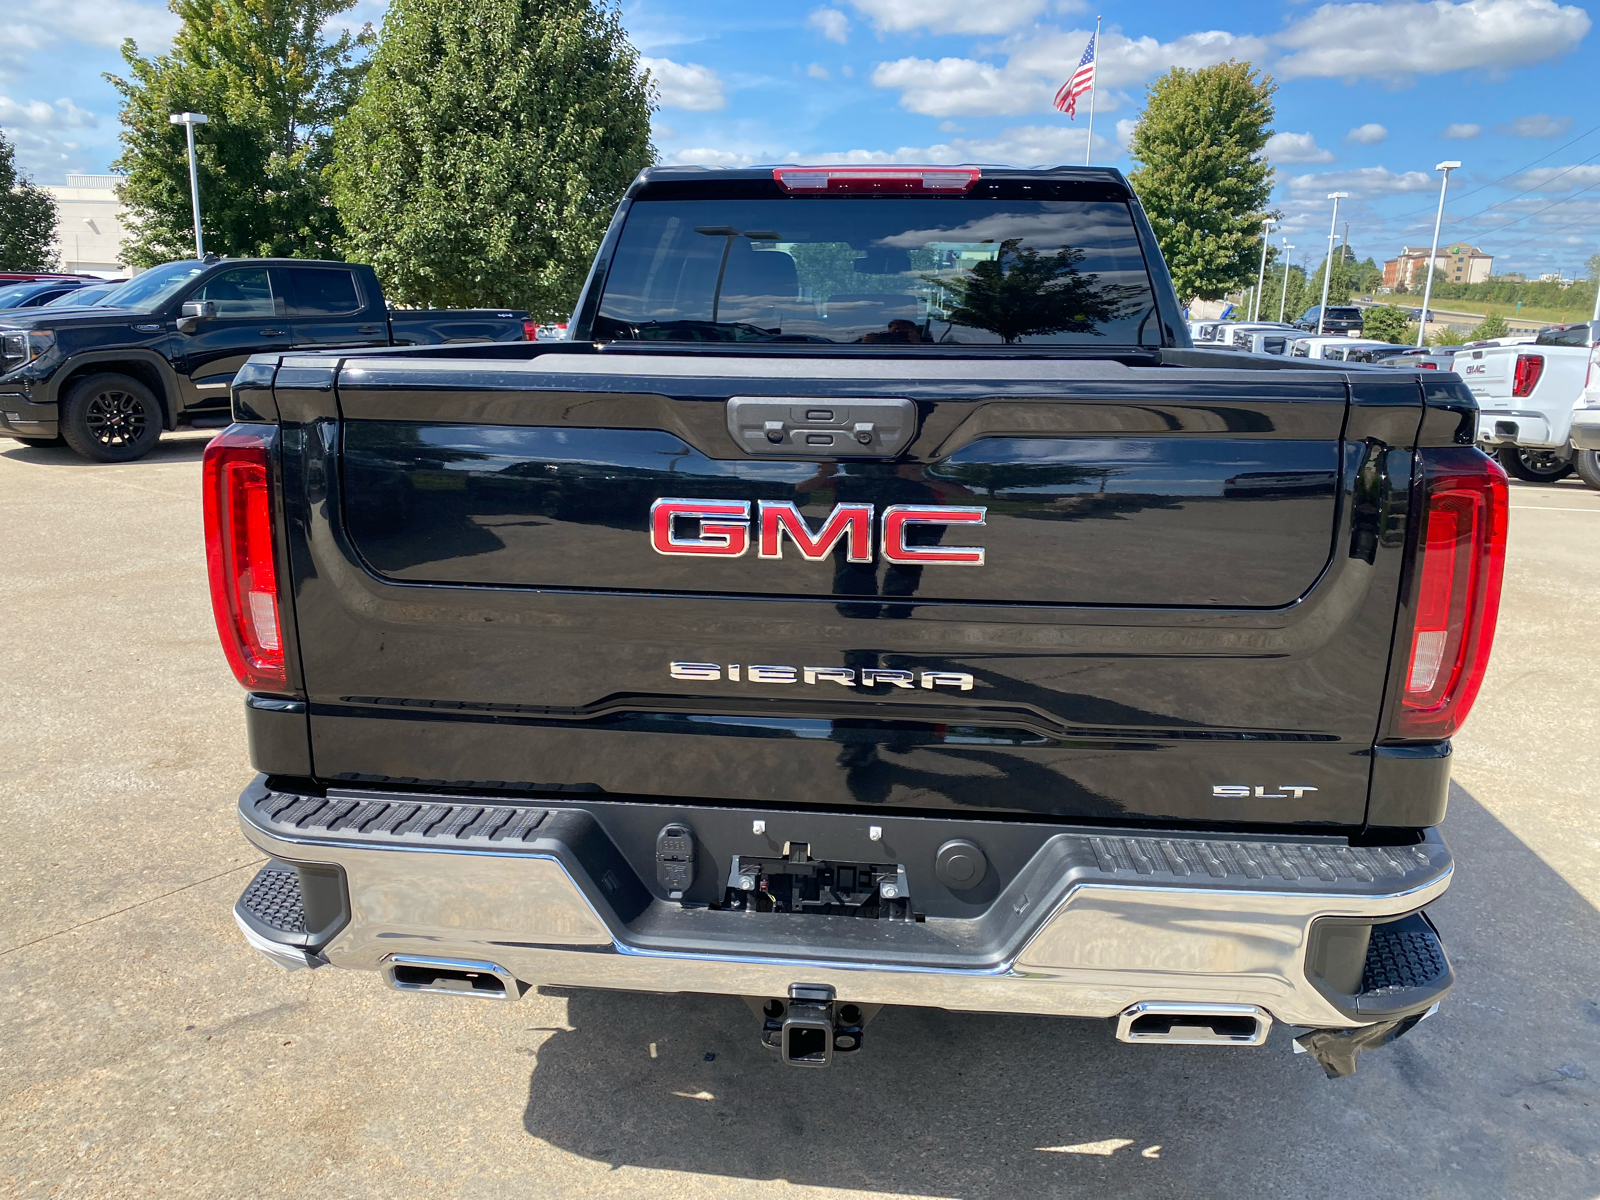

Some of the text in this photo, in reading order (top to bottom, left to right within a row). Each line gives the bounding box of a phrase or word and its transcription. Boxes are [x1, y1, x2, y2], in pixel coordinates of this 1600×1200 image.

[1465, 364, 1486, 375] GMC
[650, 497, 987, 566] GMC
[670, 661, 974, 691] SIERRA
[1212, 785, 1319, 799] SLT
